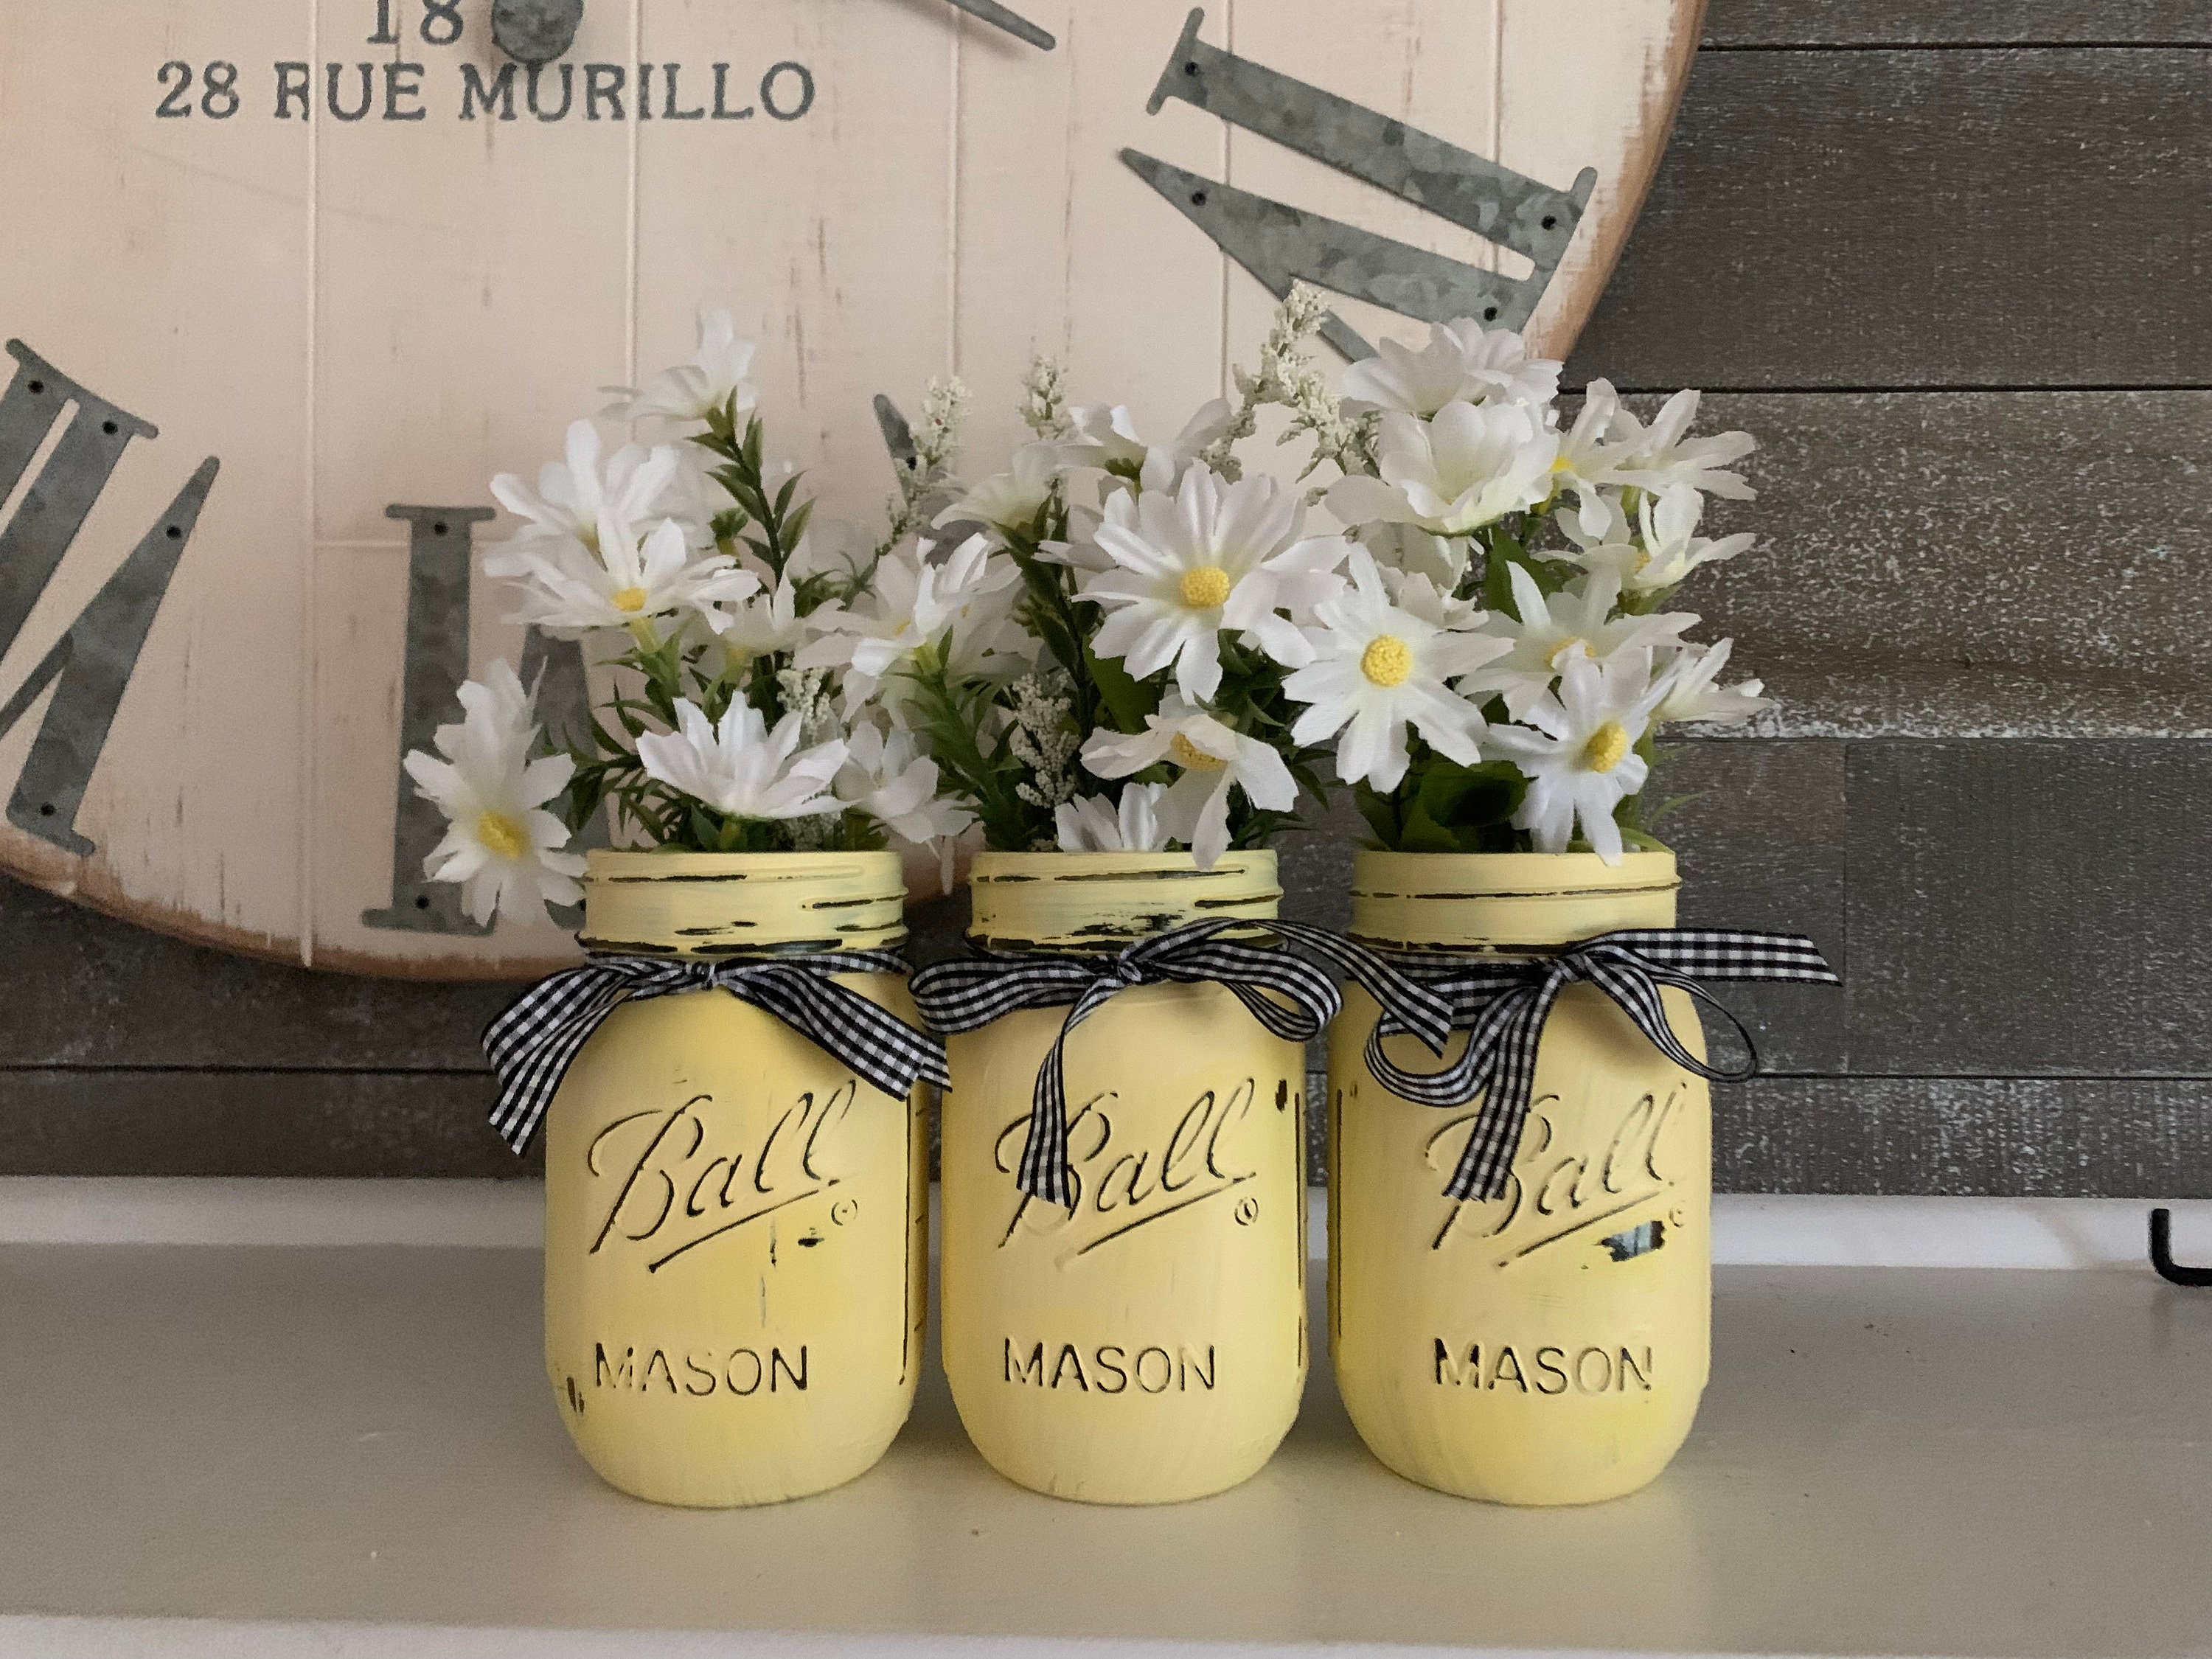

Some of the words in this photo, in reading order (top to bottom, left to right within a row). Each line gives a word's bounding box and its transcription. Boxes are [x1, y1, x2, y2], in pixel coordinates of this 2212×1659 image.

[155, 61, 239, 119] 28
[274, 62, 425, 120] RUE
[459, 62, 816, 120] MURILLO
[588, 1079, 855, 1253] Ball
[595, 1343, 807, 1396] MASON
[1004, 1338, 1215, 1394] MASON
[1433, 1338, 1652, 1395] MASON
